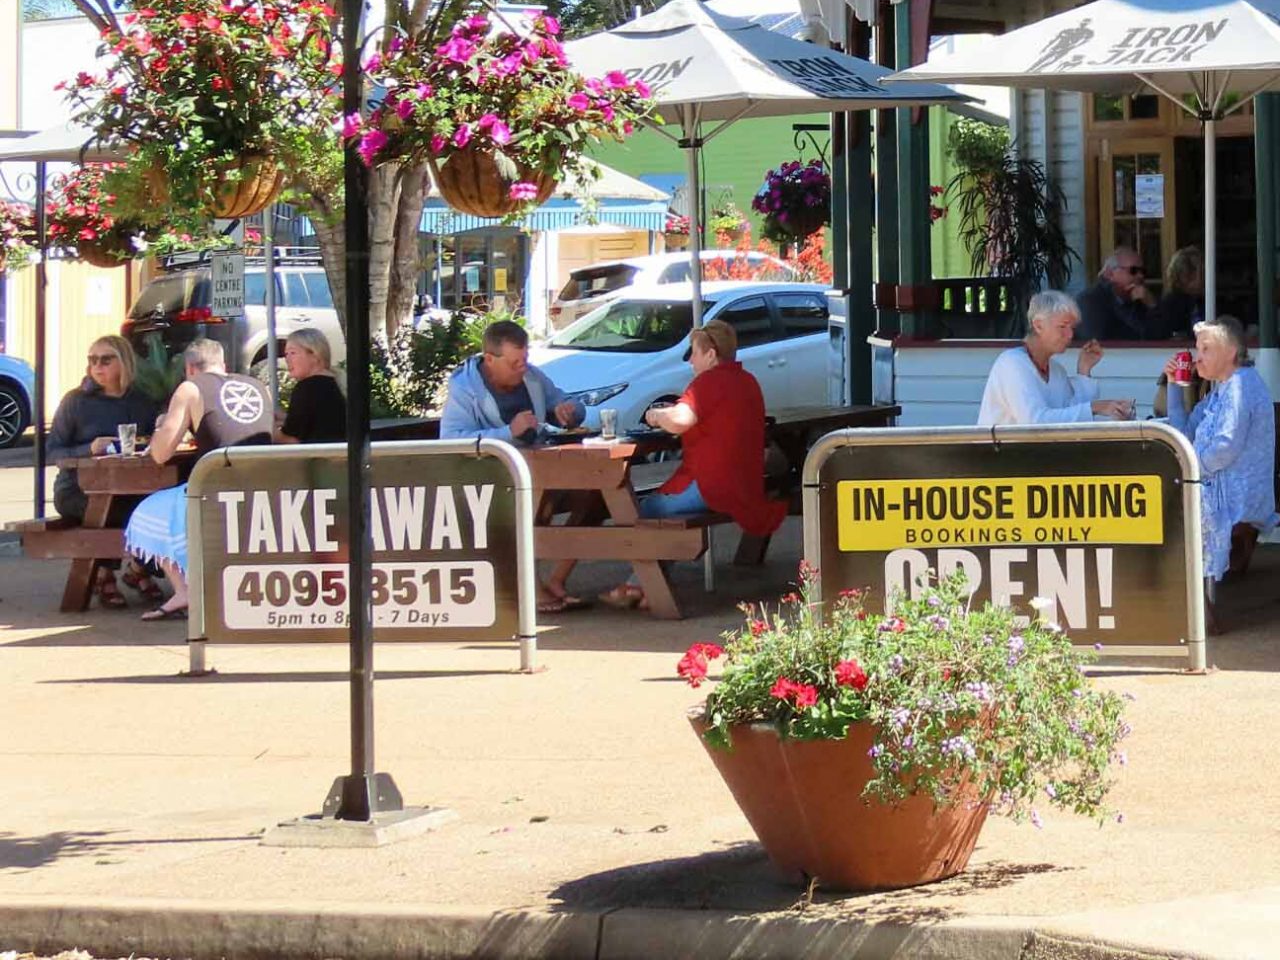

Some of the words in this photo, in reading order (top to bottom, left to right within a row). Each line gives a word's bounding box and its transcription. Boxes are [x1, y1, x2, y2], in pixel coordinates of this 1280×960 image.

[1112, 18, 1229, 48] IRON
[1087, 43, 1207, 65] JACK
[768, 57, 857, 77] IRON
[223, 262, 234, 274] NO
[215, 279, 240, 293] CENTRE
[213, 295, 243, 310] PARKING
[852, 485, 1015, 522] IN-HOUSE
[1027, 482, 1147, 518] DINING
[218, 488, 338, 554] TAKE
[905, 527, 1022, 544] BOOKINGS
[1034, 526, 1093, 543] ONLY
[237, 569, 346, 607] 4095
[267, 611, 303, 626] 5pm
[310, 612, 327, 625] to
[390, 610, 400, 623] 7
[408, 610, 450, 625] Days
